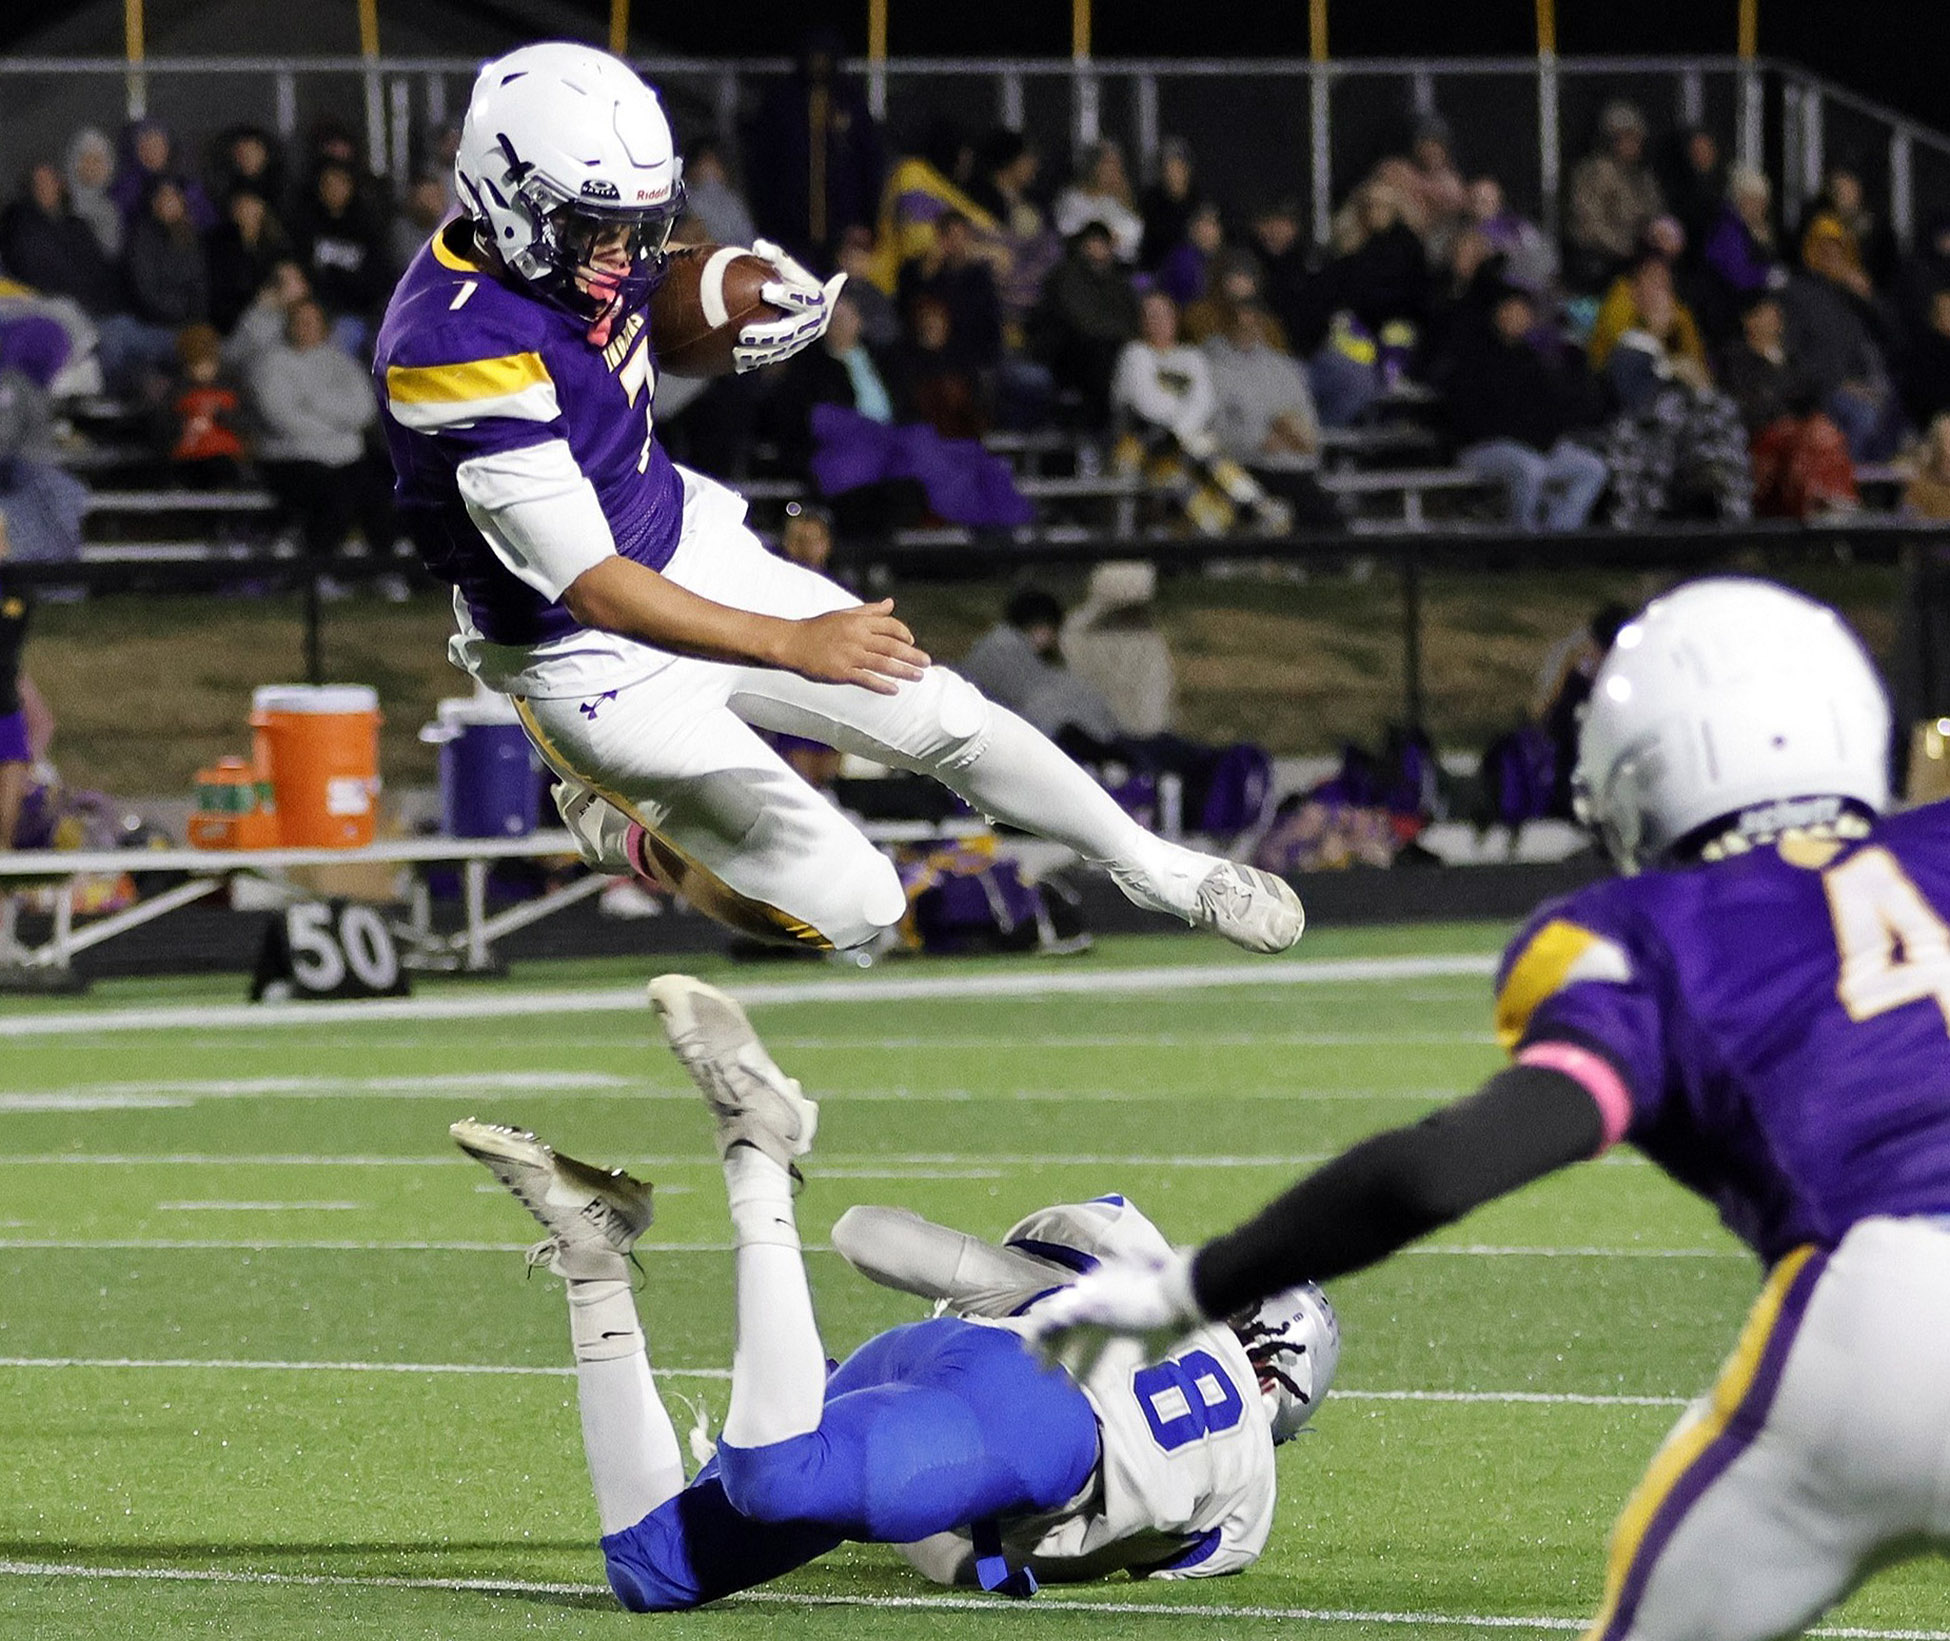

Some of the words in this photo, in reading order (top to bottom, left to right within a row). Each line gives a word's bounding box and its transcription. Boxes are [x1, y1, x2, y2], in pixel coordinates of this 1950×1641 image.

[449, 280, 478, 310] 7
[287, 902, 399, 991] 50
[1821, 845, 1950, 1042] 4
[1130, 1347, 1246, 1455] 8
